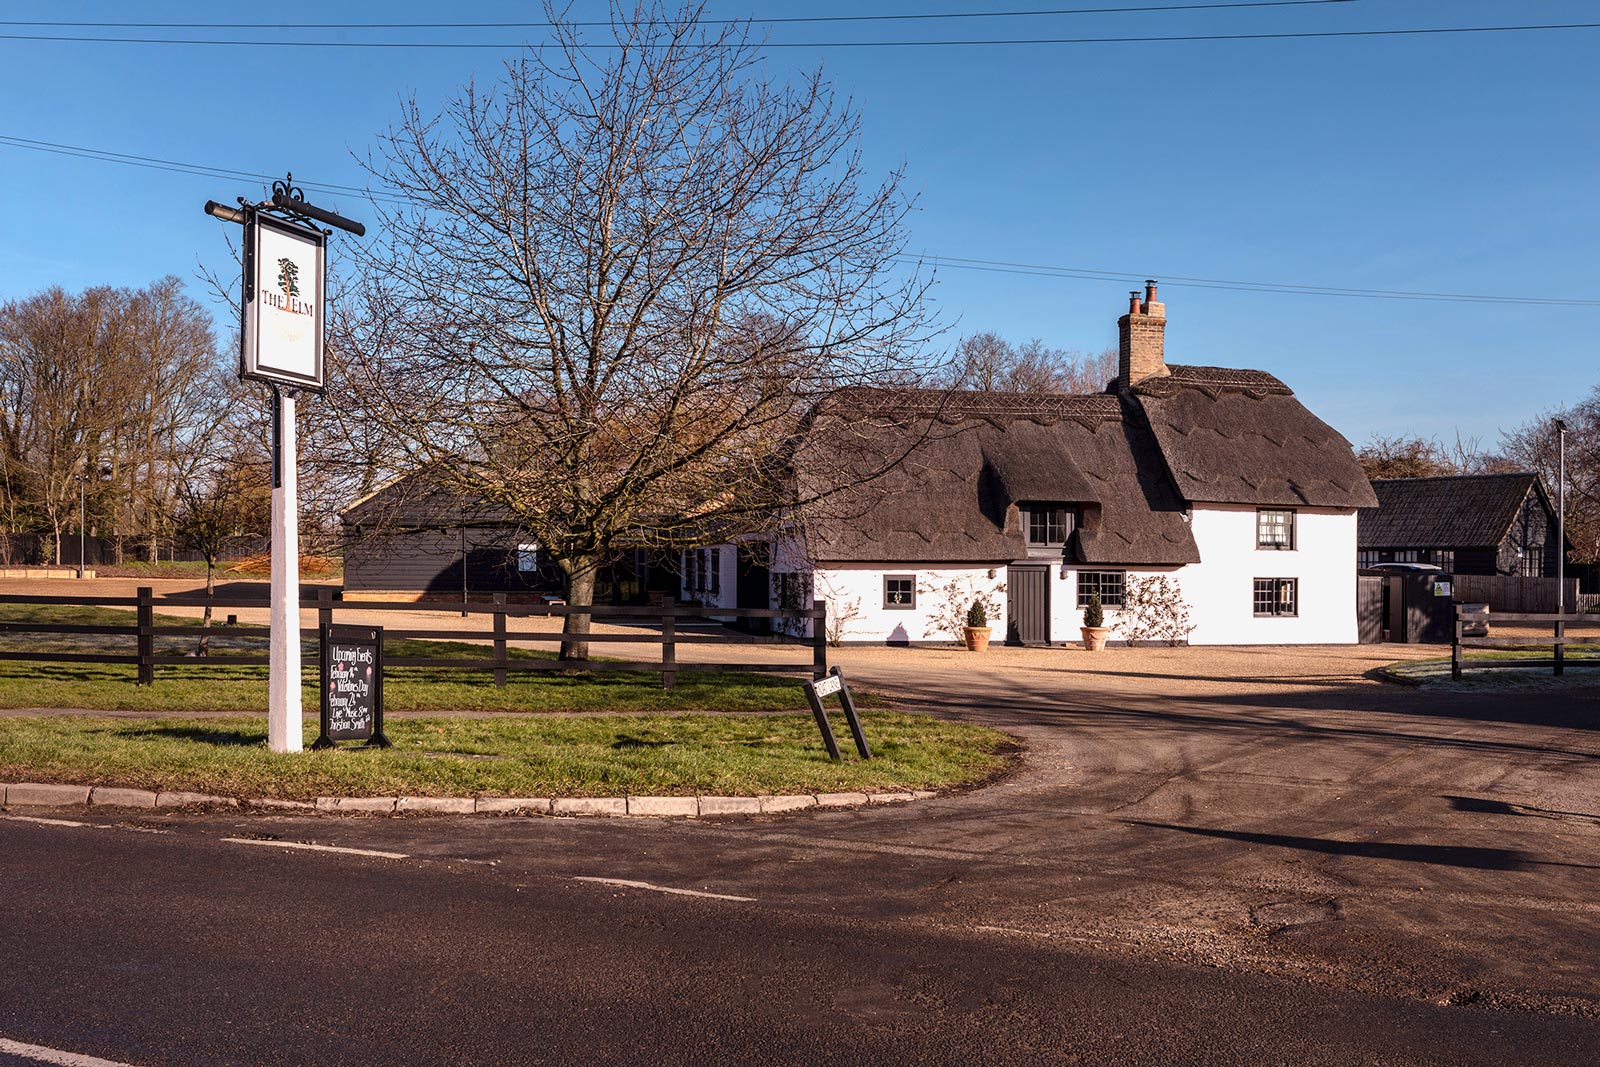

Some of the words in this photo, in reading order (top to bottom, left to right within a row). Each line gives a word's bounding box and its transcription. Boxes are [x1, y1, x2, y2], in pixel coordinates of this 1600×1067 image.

[262, 289, 284, 308] THE
[292, 298, 312, 317] ELM
[332, 646, 356, 666] Upcoming
[357, 647, 373, 664] Events
[359, 680, 368, 697] Day
[332, 708, 343, 719] Live
